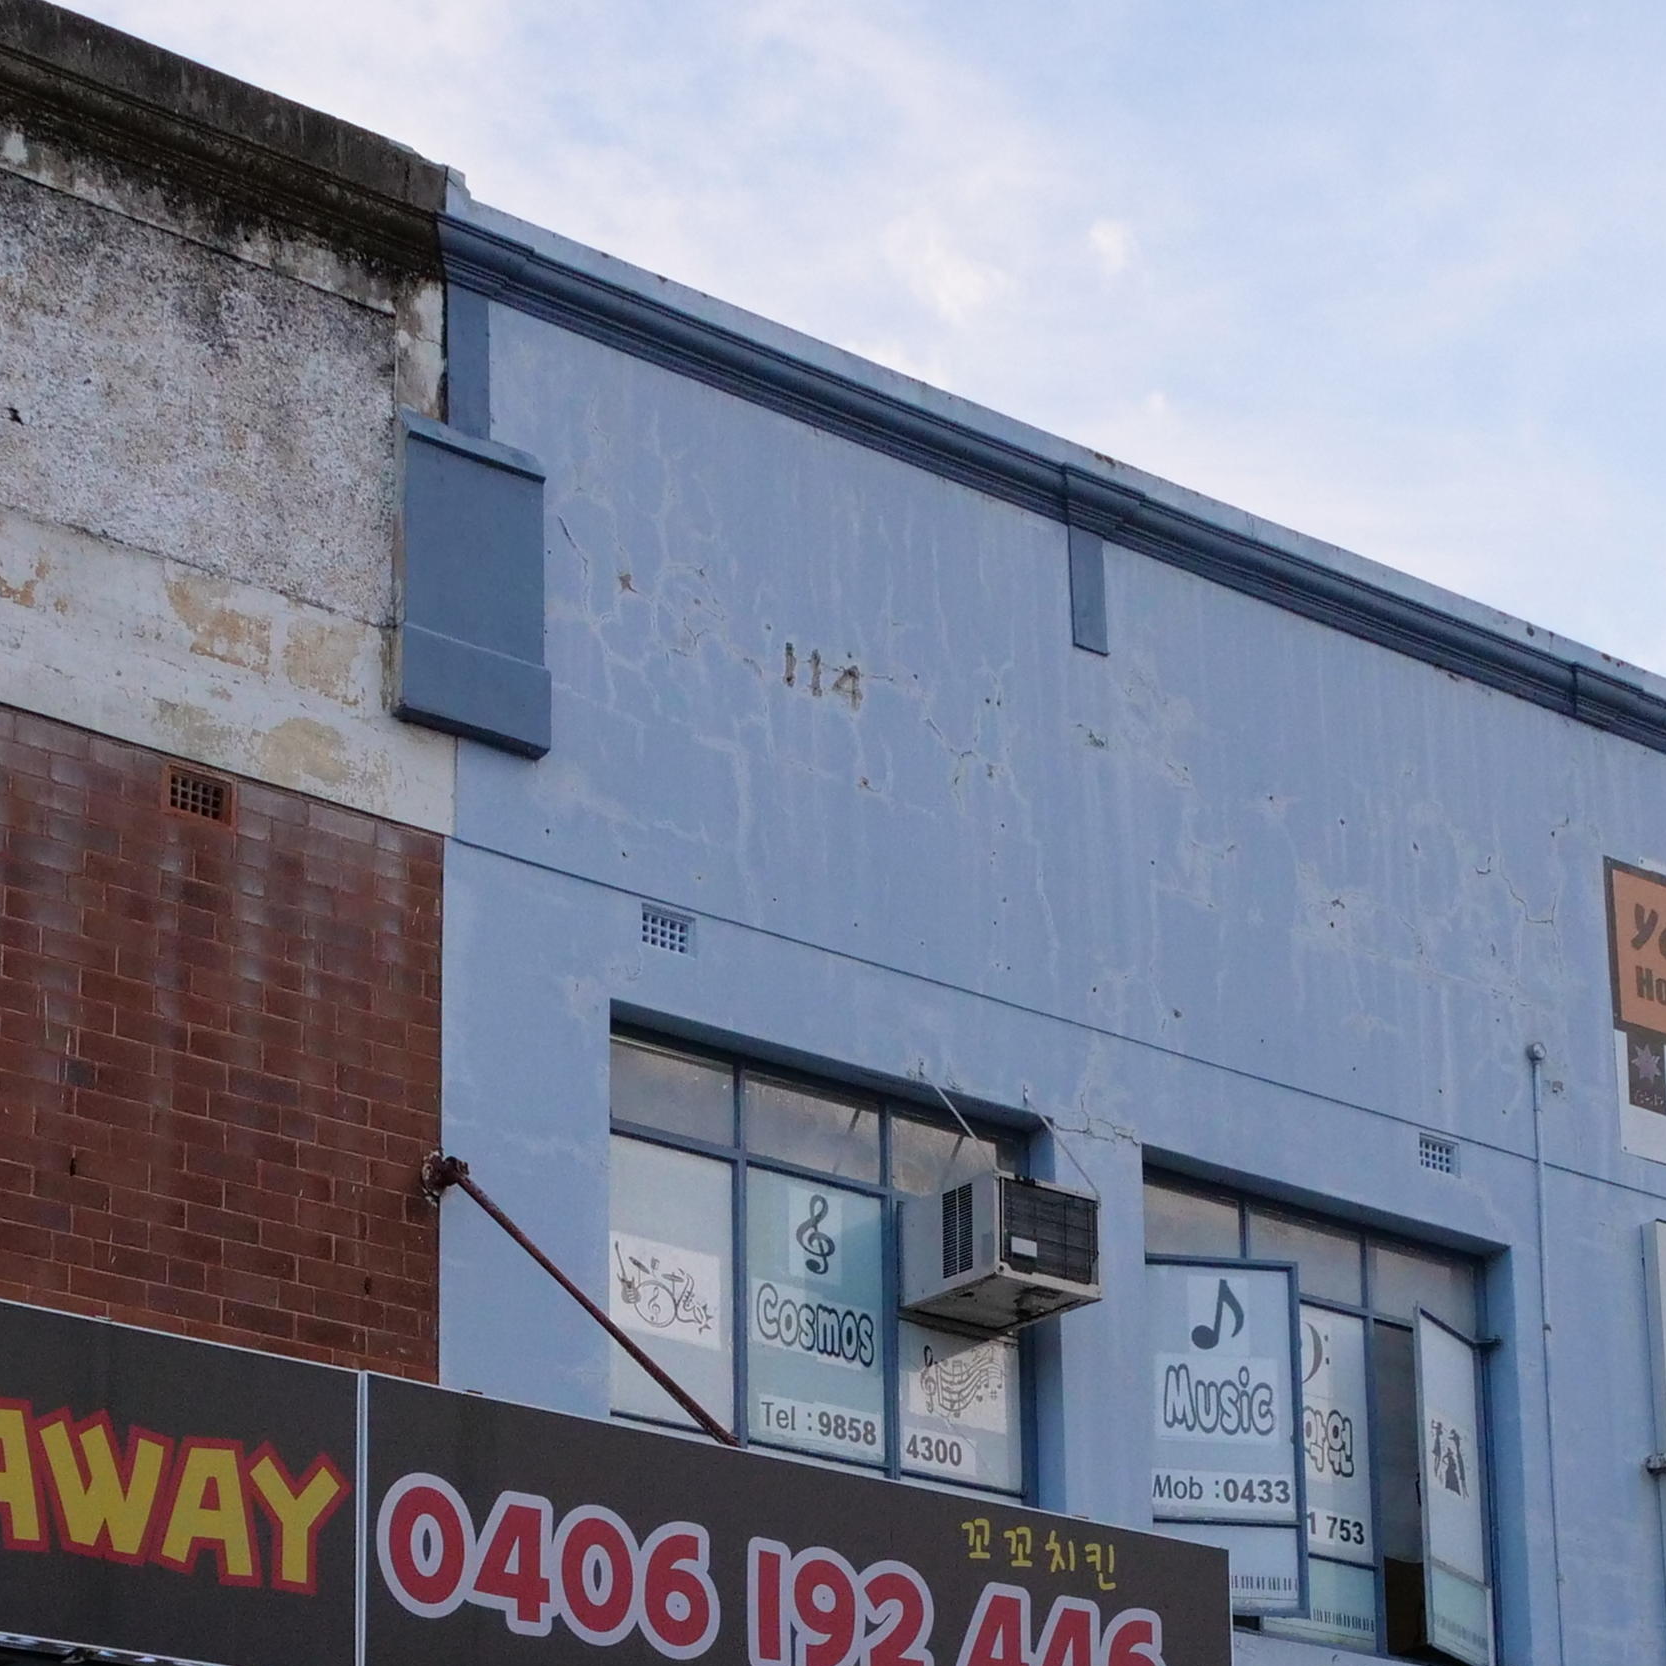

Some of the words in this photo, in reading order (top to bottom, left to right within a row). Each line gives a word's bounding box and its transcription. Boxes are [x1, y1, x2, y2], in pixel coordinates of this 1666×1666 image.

[756, 1282, 874, 1368] Cosmos
[1163, 1364, 1274, 1436] Music
[906, 1435, 962, 1468] 4300
[1153, 1474, 1203, 1500] Mob
[1327, 1516, 1364, 1544] 753
[376, 1472, 721, 1660] 0406
